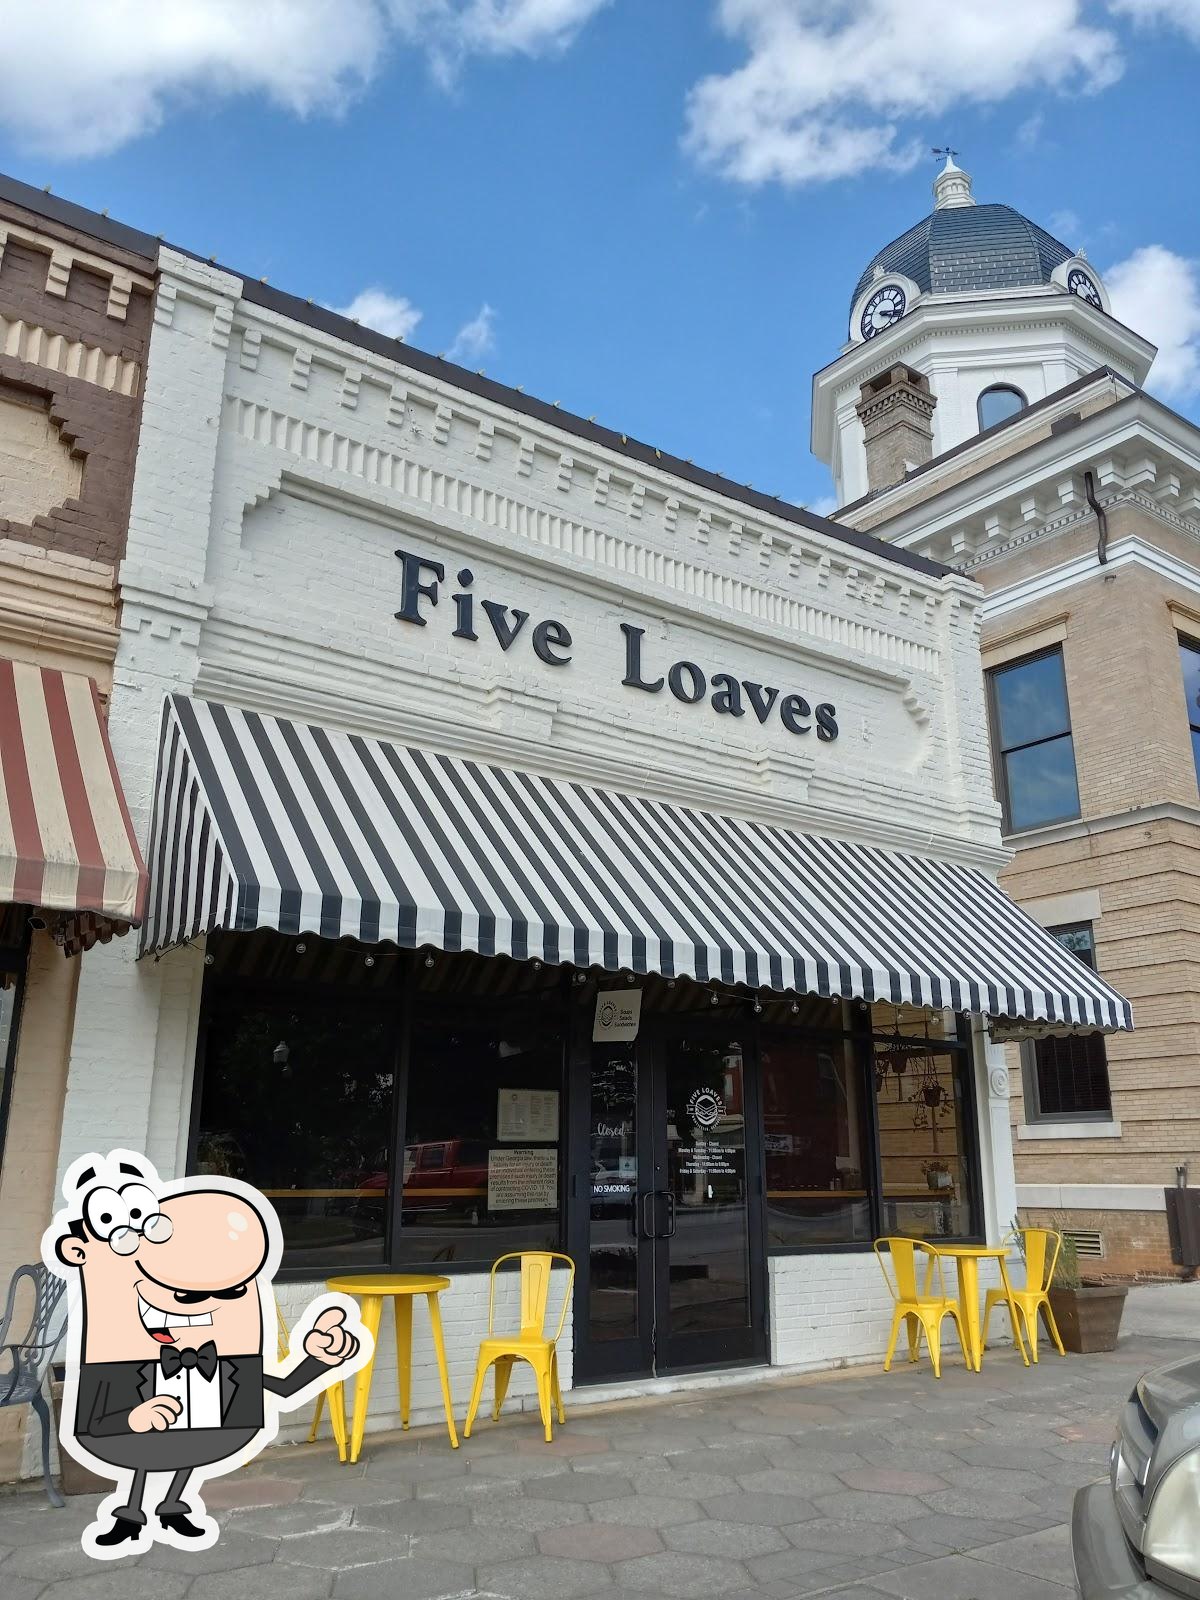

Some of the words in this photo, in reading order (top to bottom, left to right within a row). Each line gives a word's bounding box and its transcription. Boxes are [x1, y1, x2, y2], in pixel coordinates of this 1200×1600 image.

[394, 549, 573, 667] Five
[619, 622, 839, 743] Loaves
[689, 1089, 700, 1105] FIVE
[701, 1087, 723, 1106] LOAVES
[597, 1122, 625, 1137] Closed
[593, 1185, 604, 1193] NO
[604, 1185, 630, 1193] SMOKING
